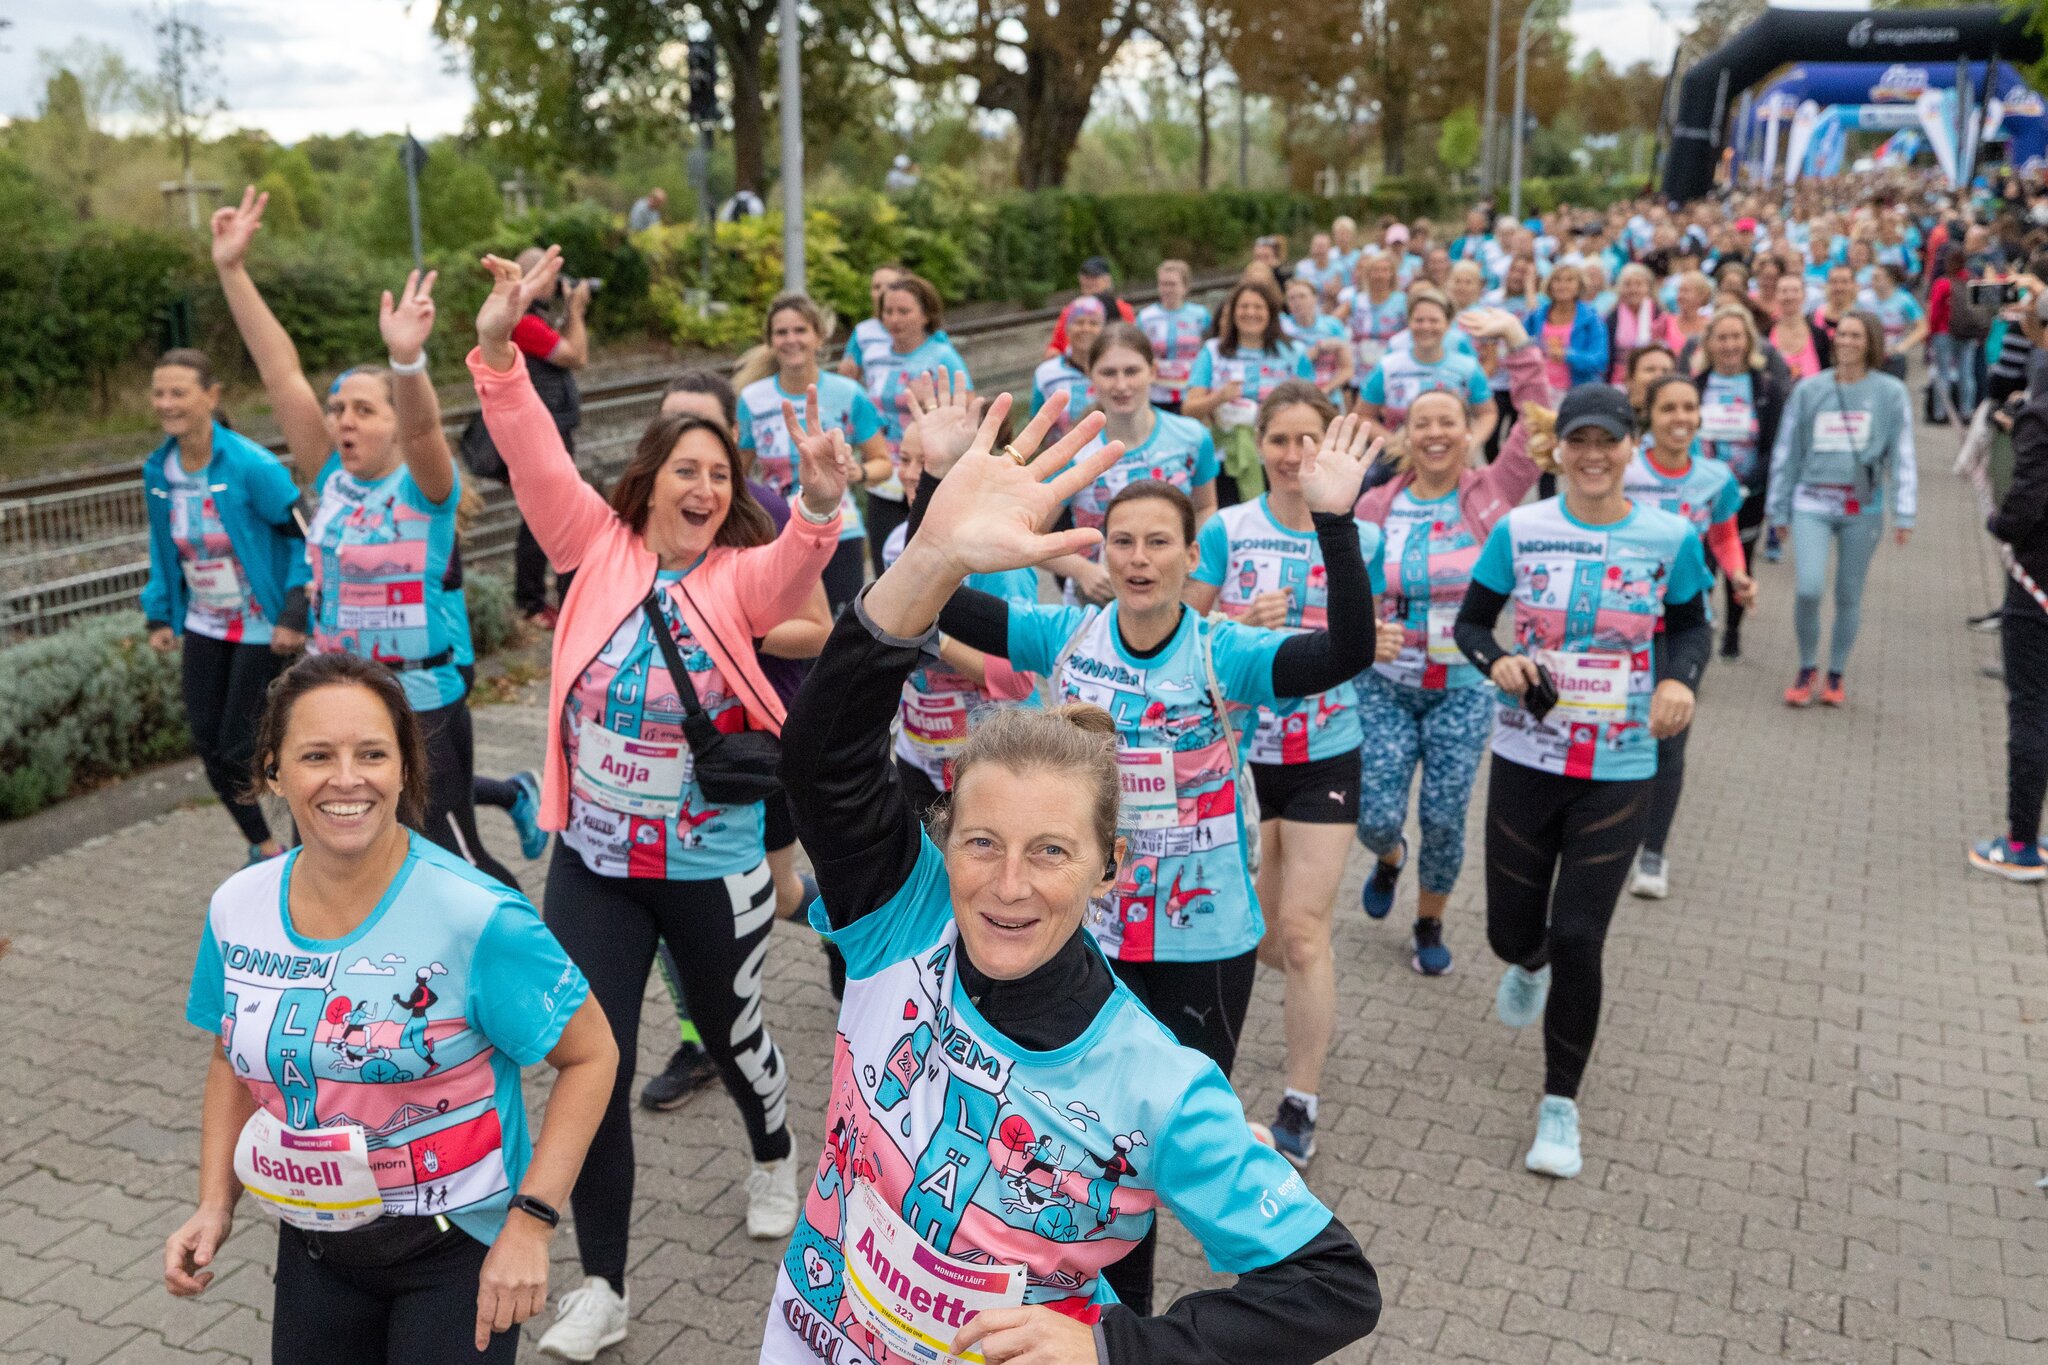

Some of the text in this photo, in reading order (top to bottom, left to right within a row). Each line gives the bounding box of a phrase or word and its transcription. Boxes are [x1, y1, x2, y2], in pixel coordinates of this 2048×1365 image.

[599, 752, 650, 785] Anja
[252, 1145, 344, 1187] Isabell
[934, 1263, 987, 1287] MONNEM LÄUFT
[894, 1303, 914, 1322] 323
